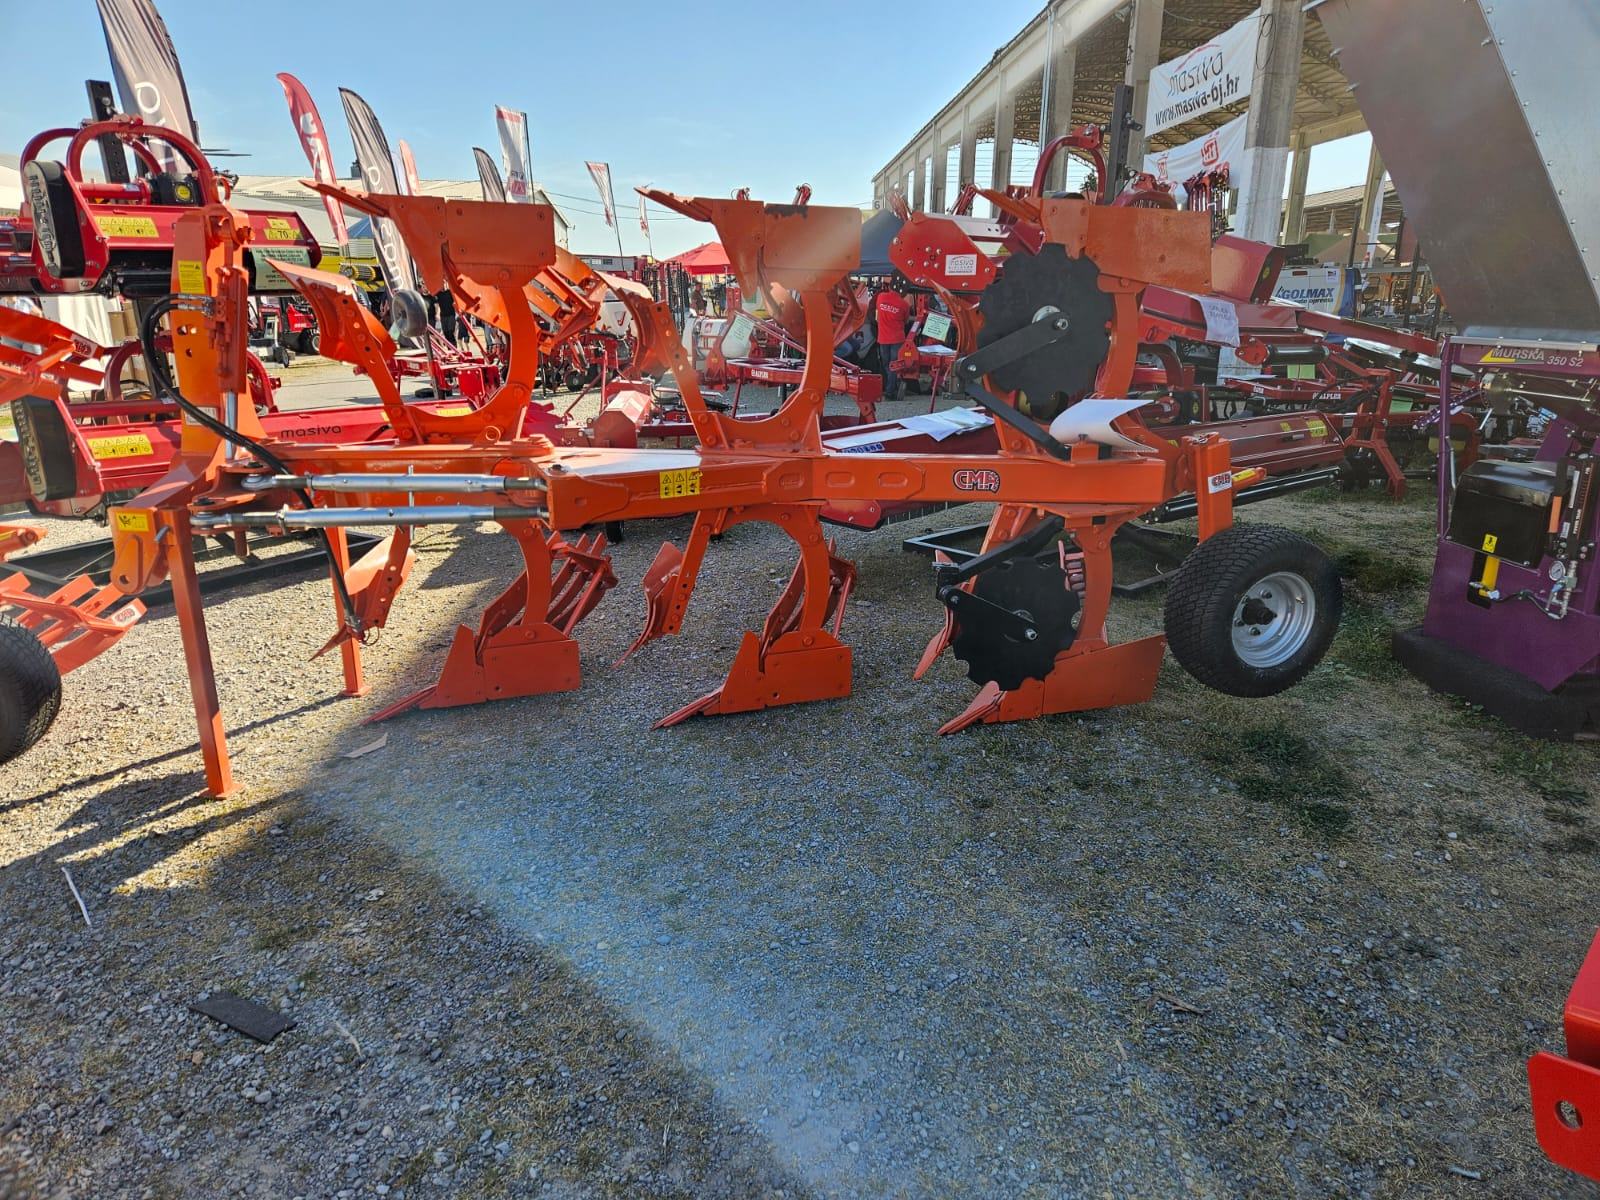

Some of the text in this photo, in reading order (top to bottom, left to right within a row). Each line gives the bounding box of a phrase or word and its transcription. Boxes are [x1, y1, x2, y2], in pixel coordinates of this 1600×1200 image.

[1167, 51, 1223, 97] masiva
[1155, 73, 1240, 126] www.masiva-bj.hr
[1492, 348, 1584, 367] MURSKA 350 S2
[281, 425, 342, 438] masiva
